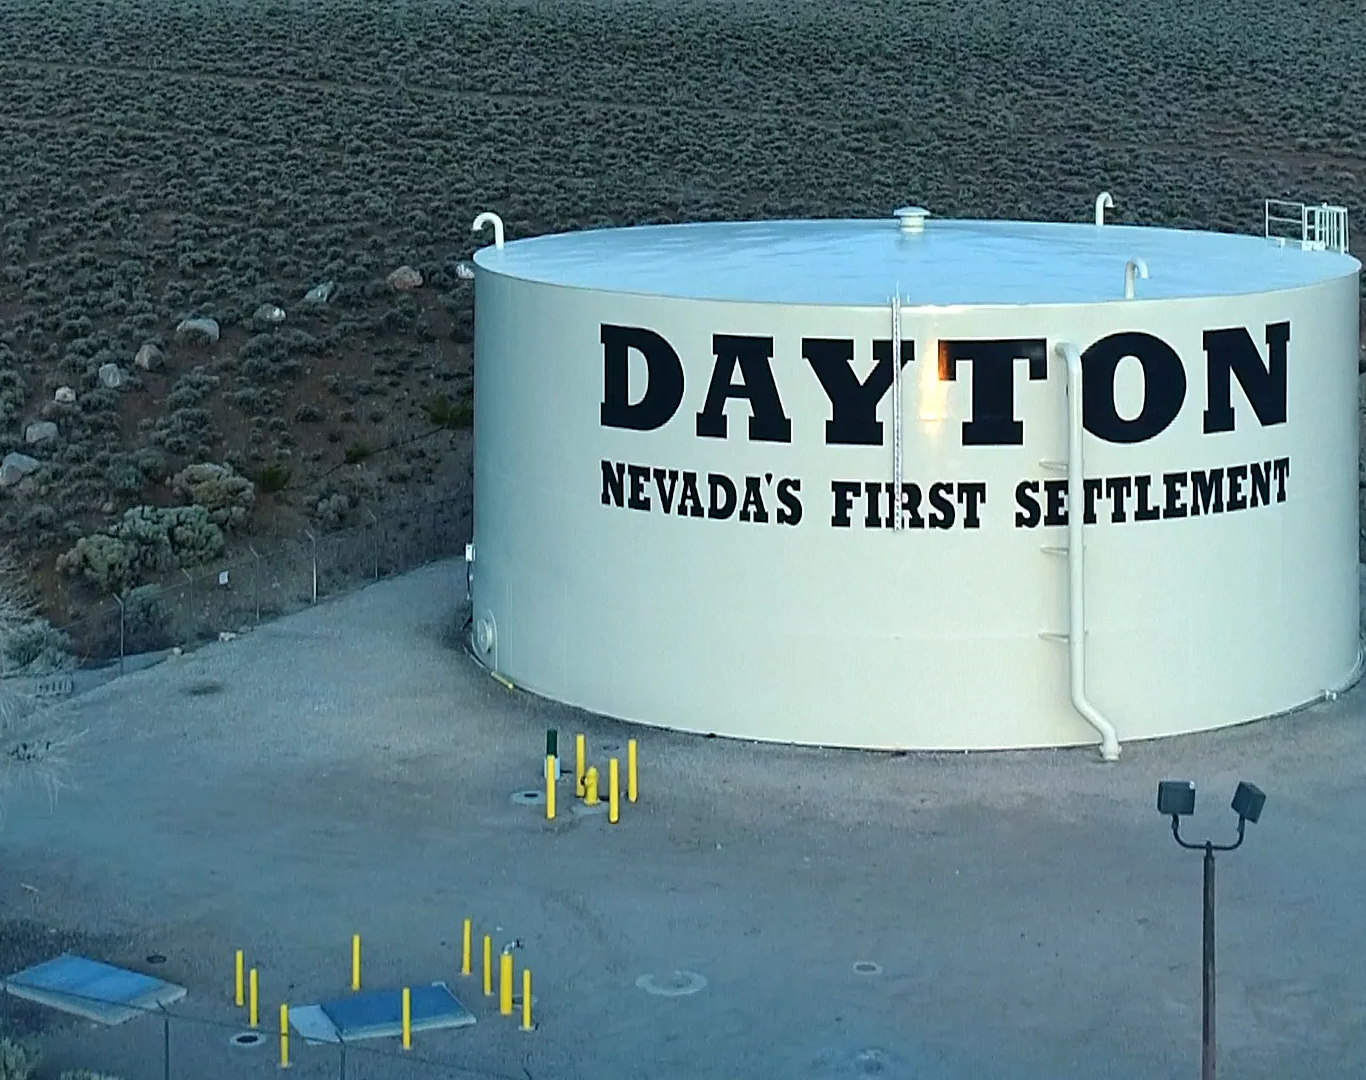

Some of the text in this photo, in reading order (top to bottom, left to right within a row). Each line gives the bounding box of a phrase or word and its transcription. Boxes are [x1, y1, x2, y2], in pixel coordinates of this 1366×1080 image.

[601, 321, 1291, 446] DAYTON
[601, 458, 1290, 530] NEVADA'S FIRST SETTLEMENT
